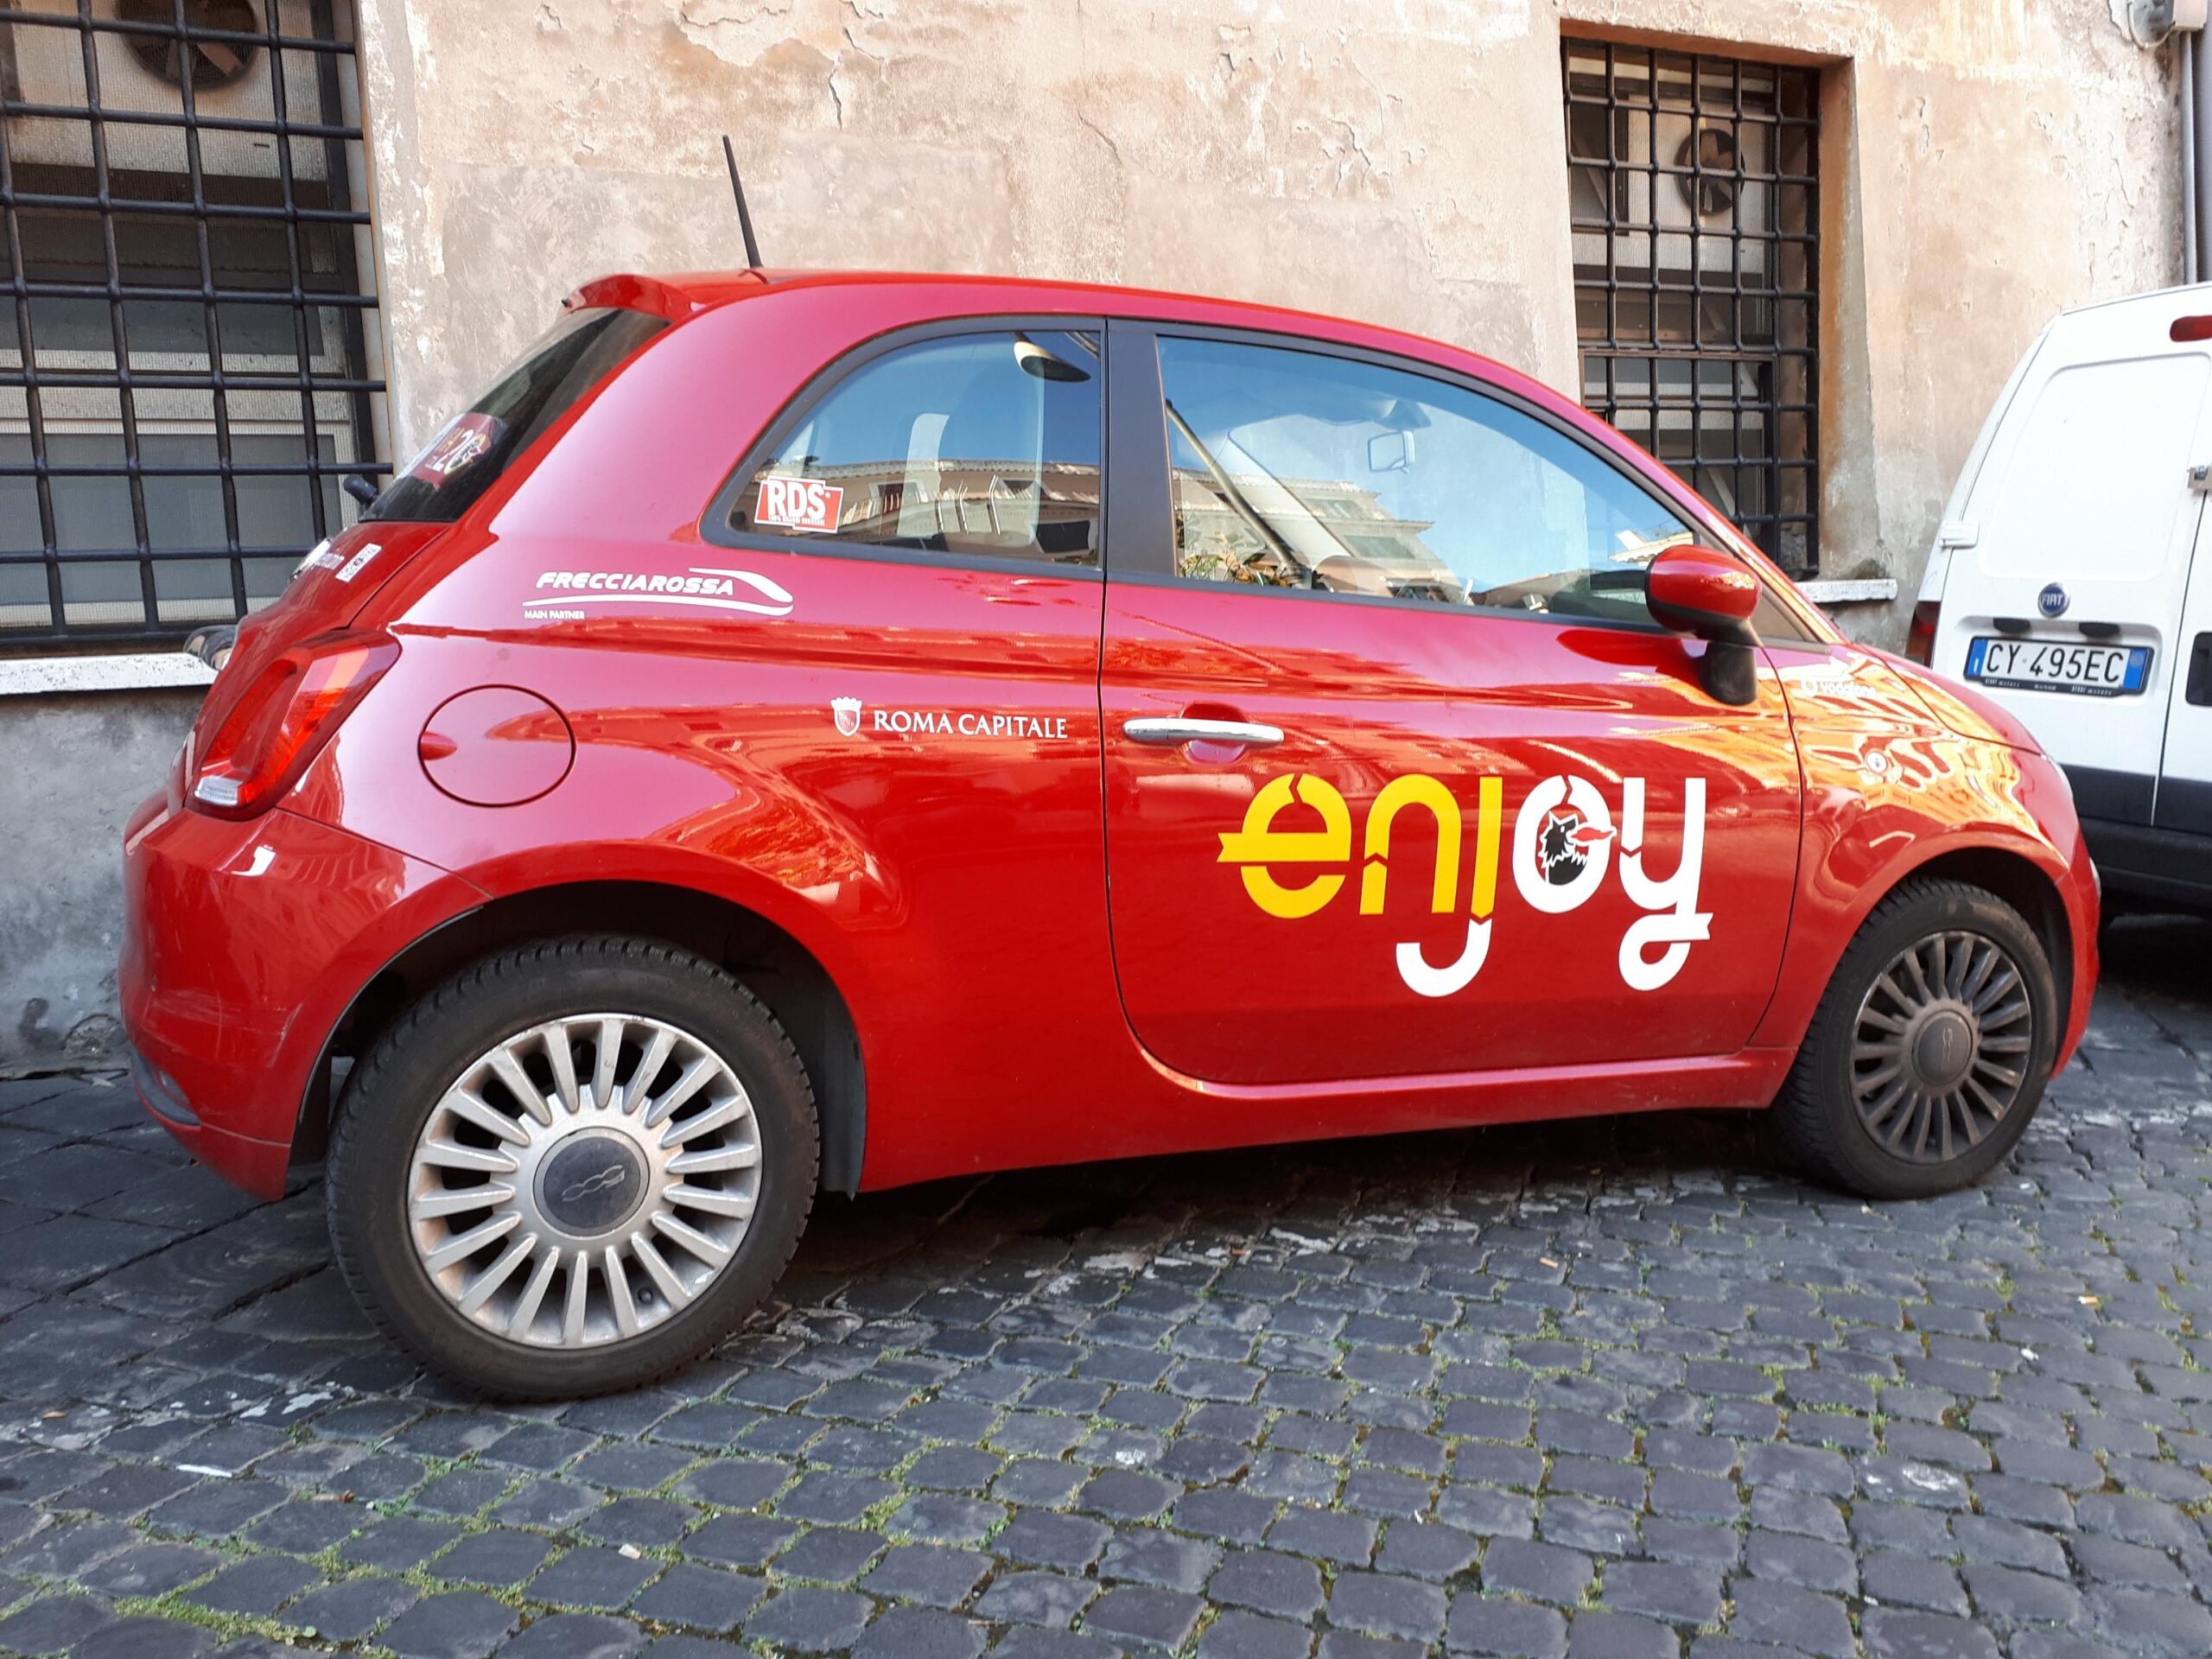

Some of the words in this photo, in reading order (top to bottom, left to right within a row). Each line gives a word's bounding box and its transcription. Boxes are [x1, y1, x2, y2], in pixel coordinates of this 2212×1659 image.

[766, 480, 827, 520] RDS
[536, 571, 734, 596] FRECCIAROSSA
[524, 609, 548, 619] MAIN
[549, 610, 585, 620] PARTNER
[2041, 593, 2063, 606] FIAT
[1986, 644, 2021, 675] CY
[2030, 646, 2124, 683] 495EC
[874, 709, 954, 734] ROMA
[957, 713, 1069, 739] CAPITALE
[1216, 772, 1714, 998] enjoy
